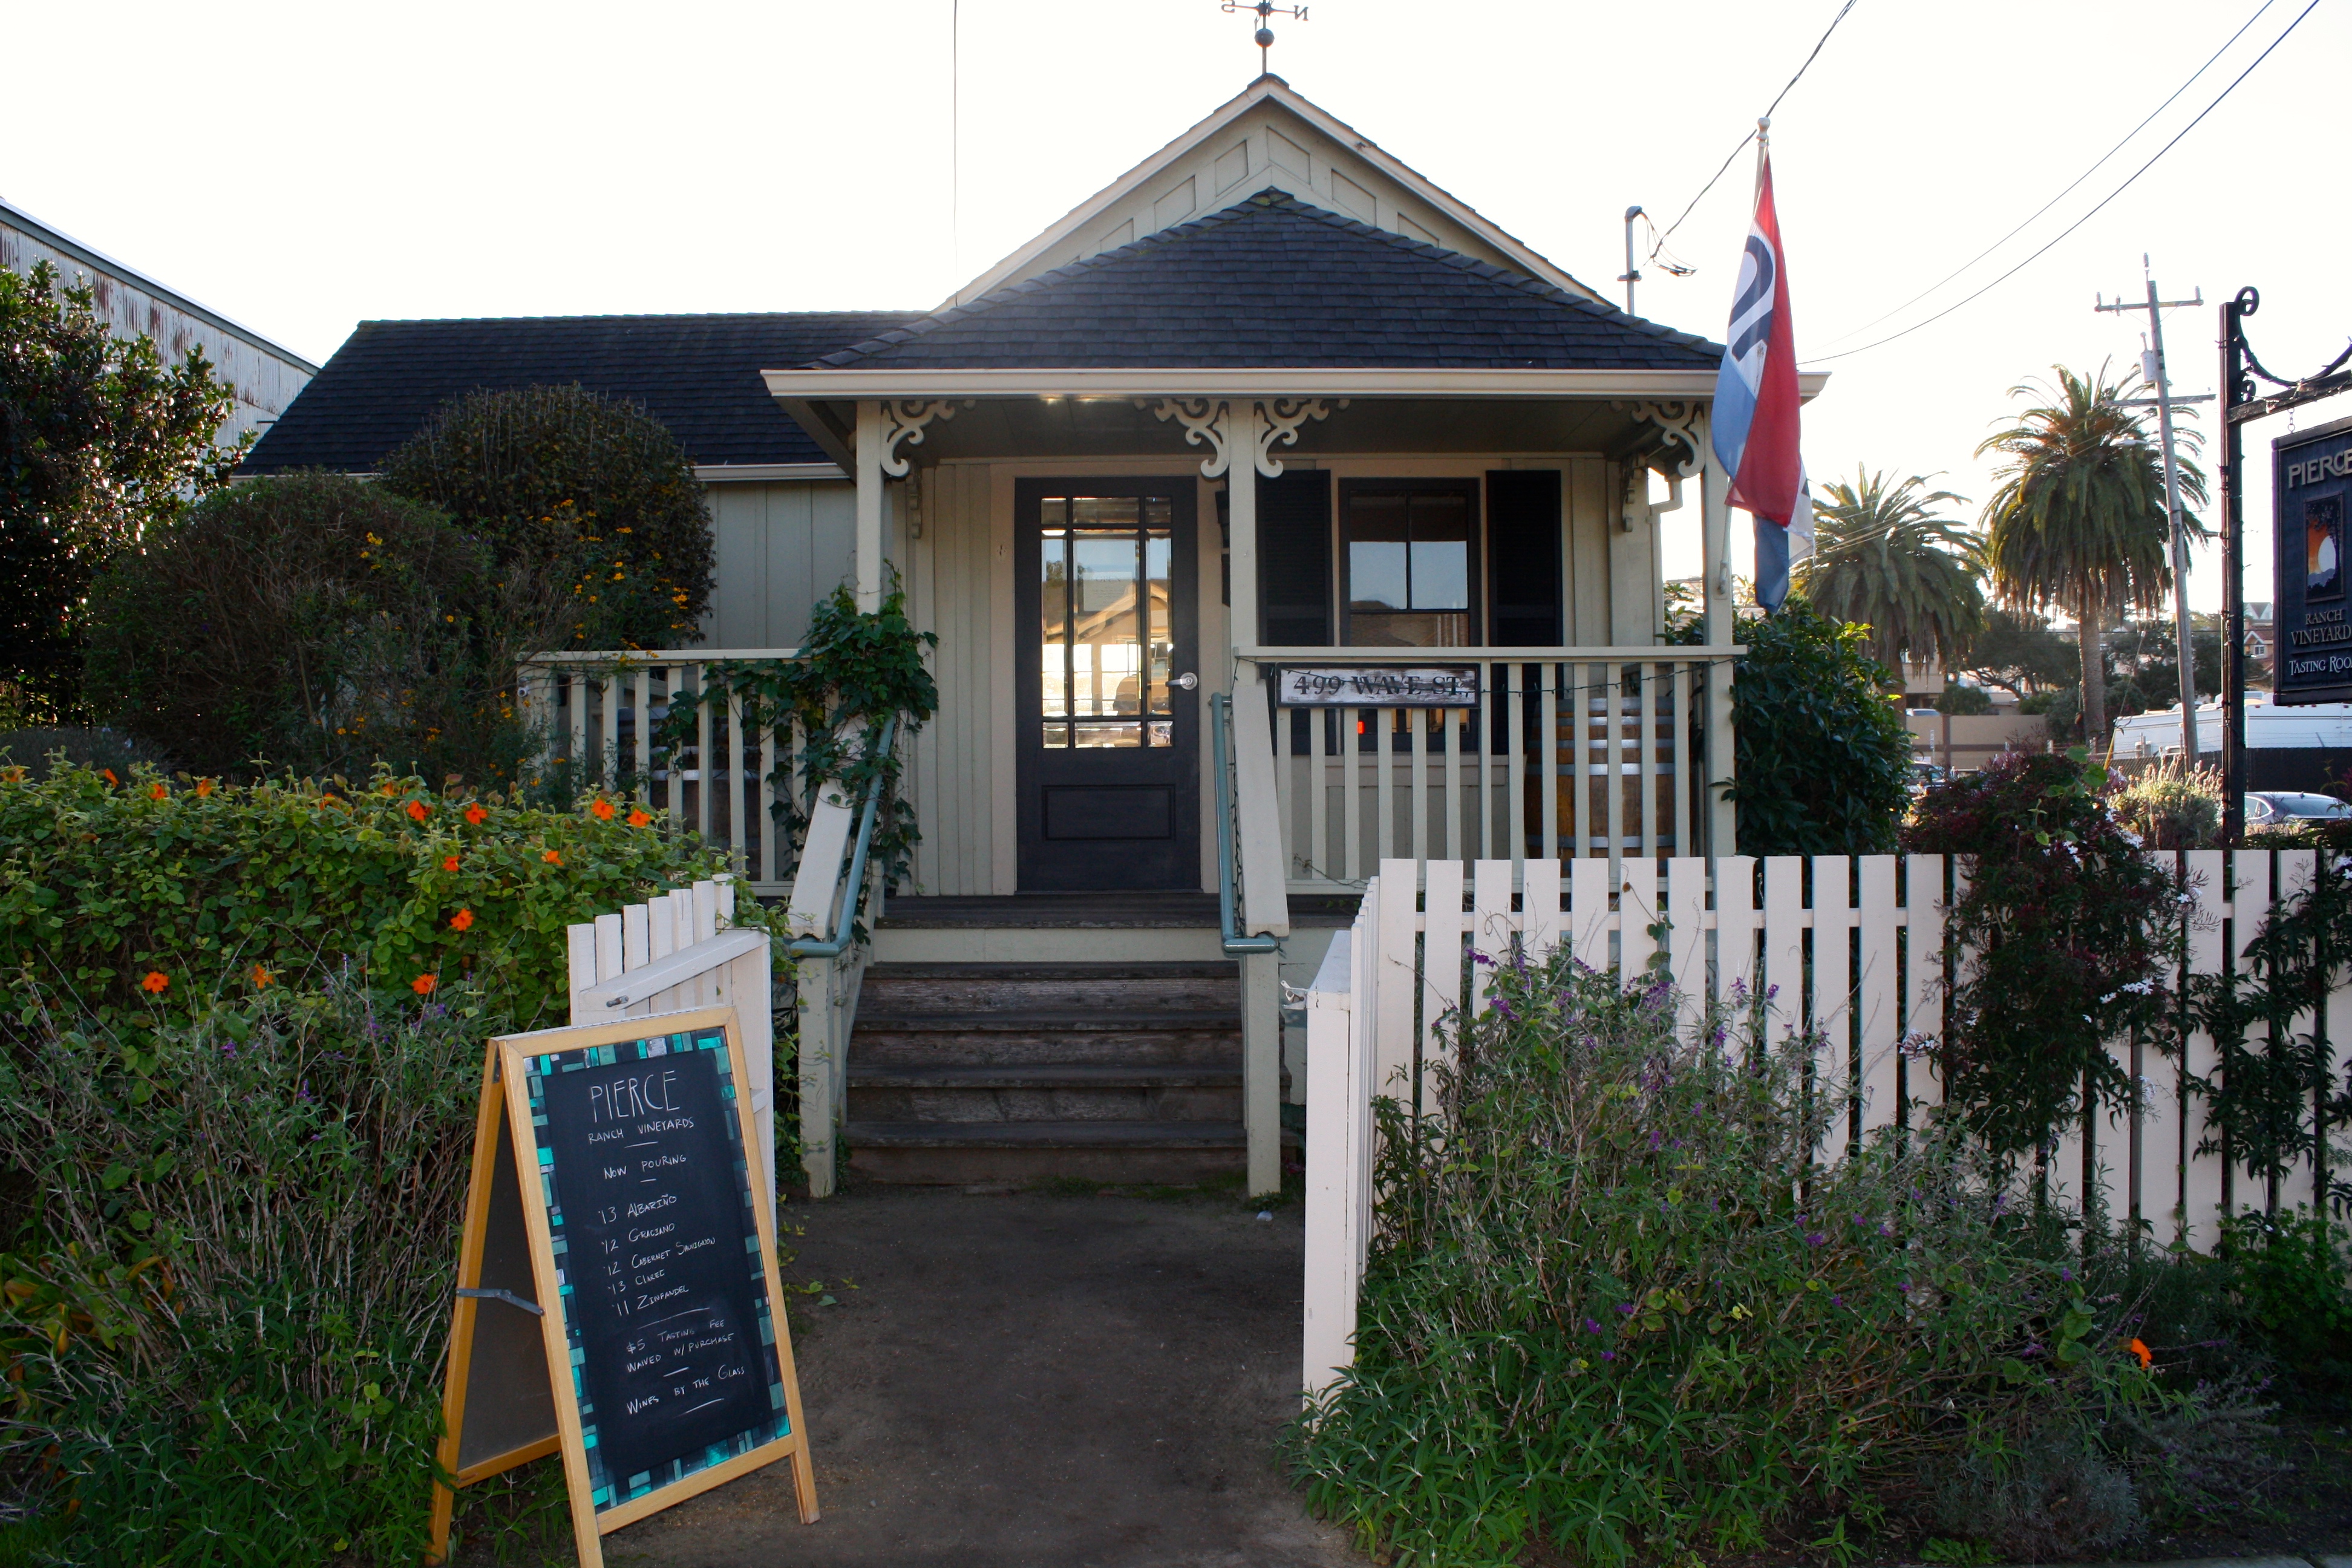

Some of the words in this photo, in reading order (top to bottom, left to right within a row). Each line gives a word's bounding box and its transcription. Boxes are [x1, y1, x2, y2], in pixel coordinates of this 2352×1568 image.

[2288, 448, 2352, 489] PIERCE
[2305, 609, 2344, 625] RANCH
[2288, 659, 2326, 676] TASTING
[2329, 656, 2352, 673] ROO
[1293, 675, 1342, 695] 499
[1351, 676, 1422, 695] WAVE
[590, 1070, 681, 1123] PIERCE
[588, 1128, 624, 1145] RANCH
[637, 1116, 694, 1134] VINEYARDS
[603, 1165, 627, 1180] NOW
[641, 1154, 687, 1172] POURING
[628, 1223, 675, 1242] GRACIANO
[631, 1249, 671, 1269] CABERNET
[676, 1236, 716, 1255] SAUVIGNON
[637, 1285, 690, 1310] ZINFANDEL
[626, 1338, 646, 1354] $5
[657, 1328, 696, 1342] TASTING
[709, 1319, 725, 1329] FEE
[626, 1354, 662, 1373] WAIVED
[626, 1395, 659, 1416] WINES
[674, 1385, 685, 1396] BY
[692, 1376, 710, 1388] THE
[717, 1364, 745, 1379] GLASS
